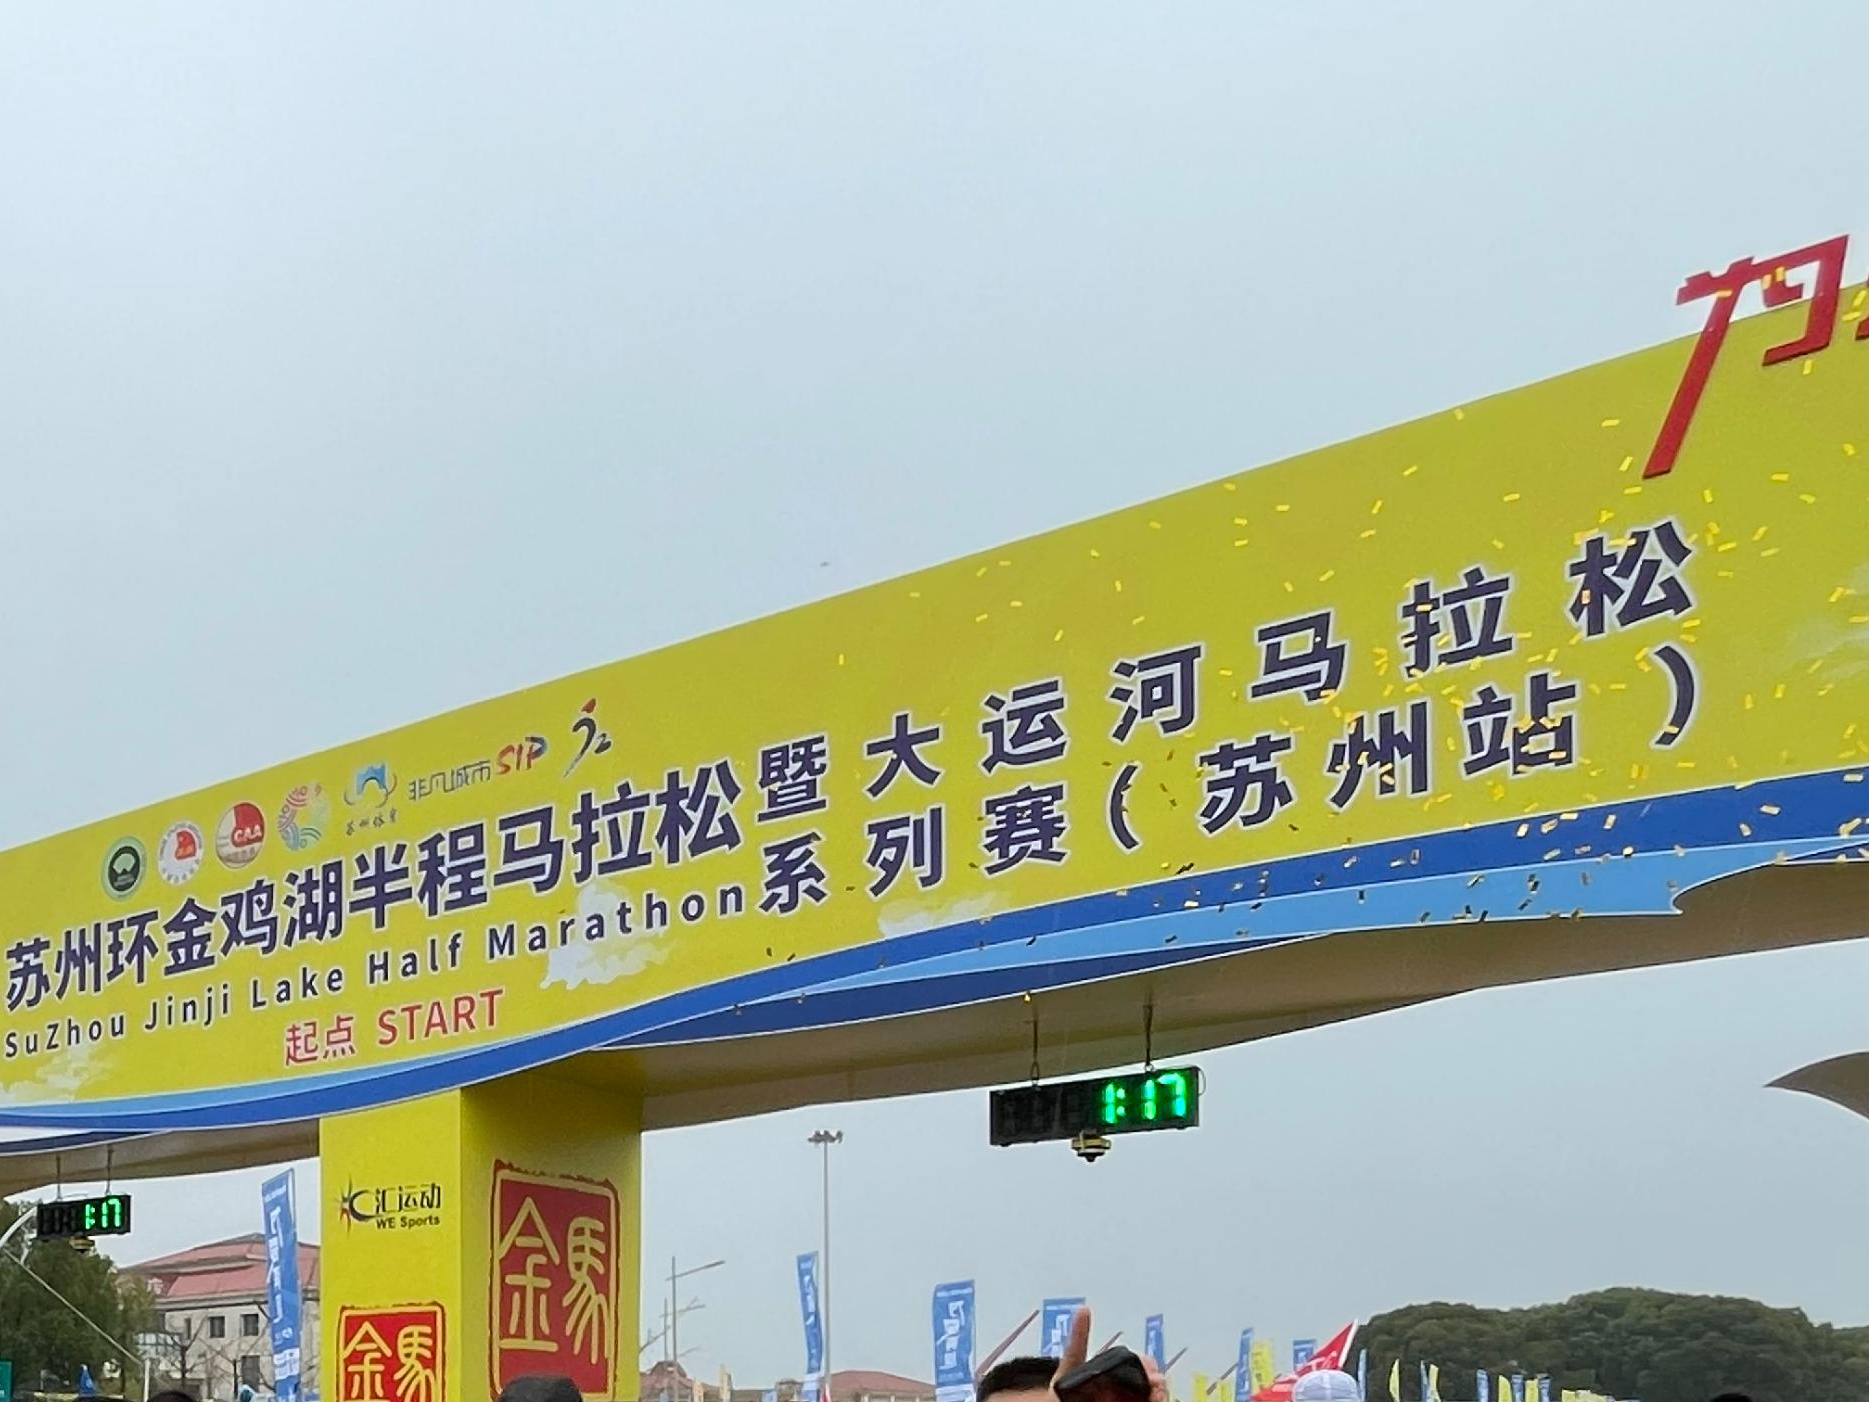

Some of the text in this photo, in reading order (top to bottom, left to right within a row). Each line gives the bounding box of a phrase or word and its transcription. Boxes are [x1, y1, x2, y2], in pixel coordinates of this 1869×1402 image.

[6, 1014, 125, 1059] SuZhou
[145, 994, 230, 1033] Jinji
[252, 957, 344, 1008] Lake
[368, 942, 463, 985] Half
[487, 885, 744, 961] Marathon
[284, 988, 504, 1067] 起点 START
[1104, 1071, 1187, 1124] 1:17
[85, 1198, 121, 1230] 1:17
[400, 1215, 441, 1231] Sports
